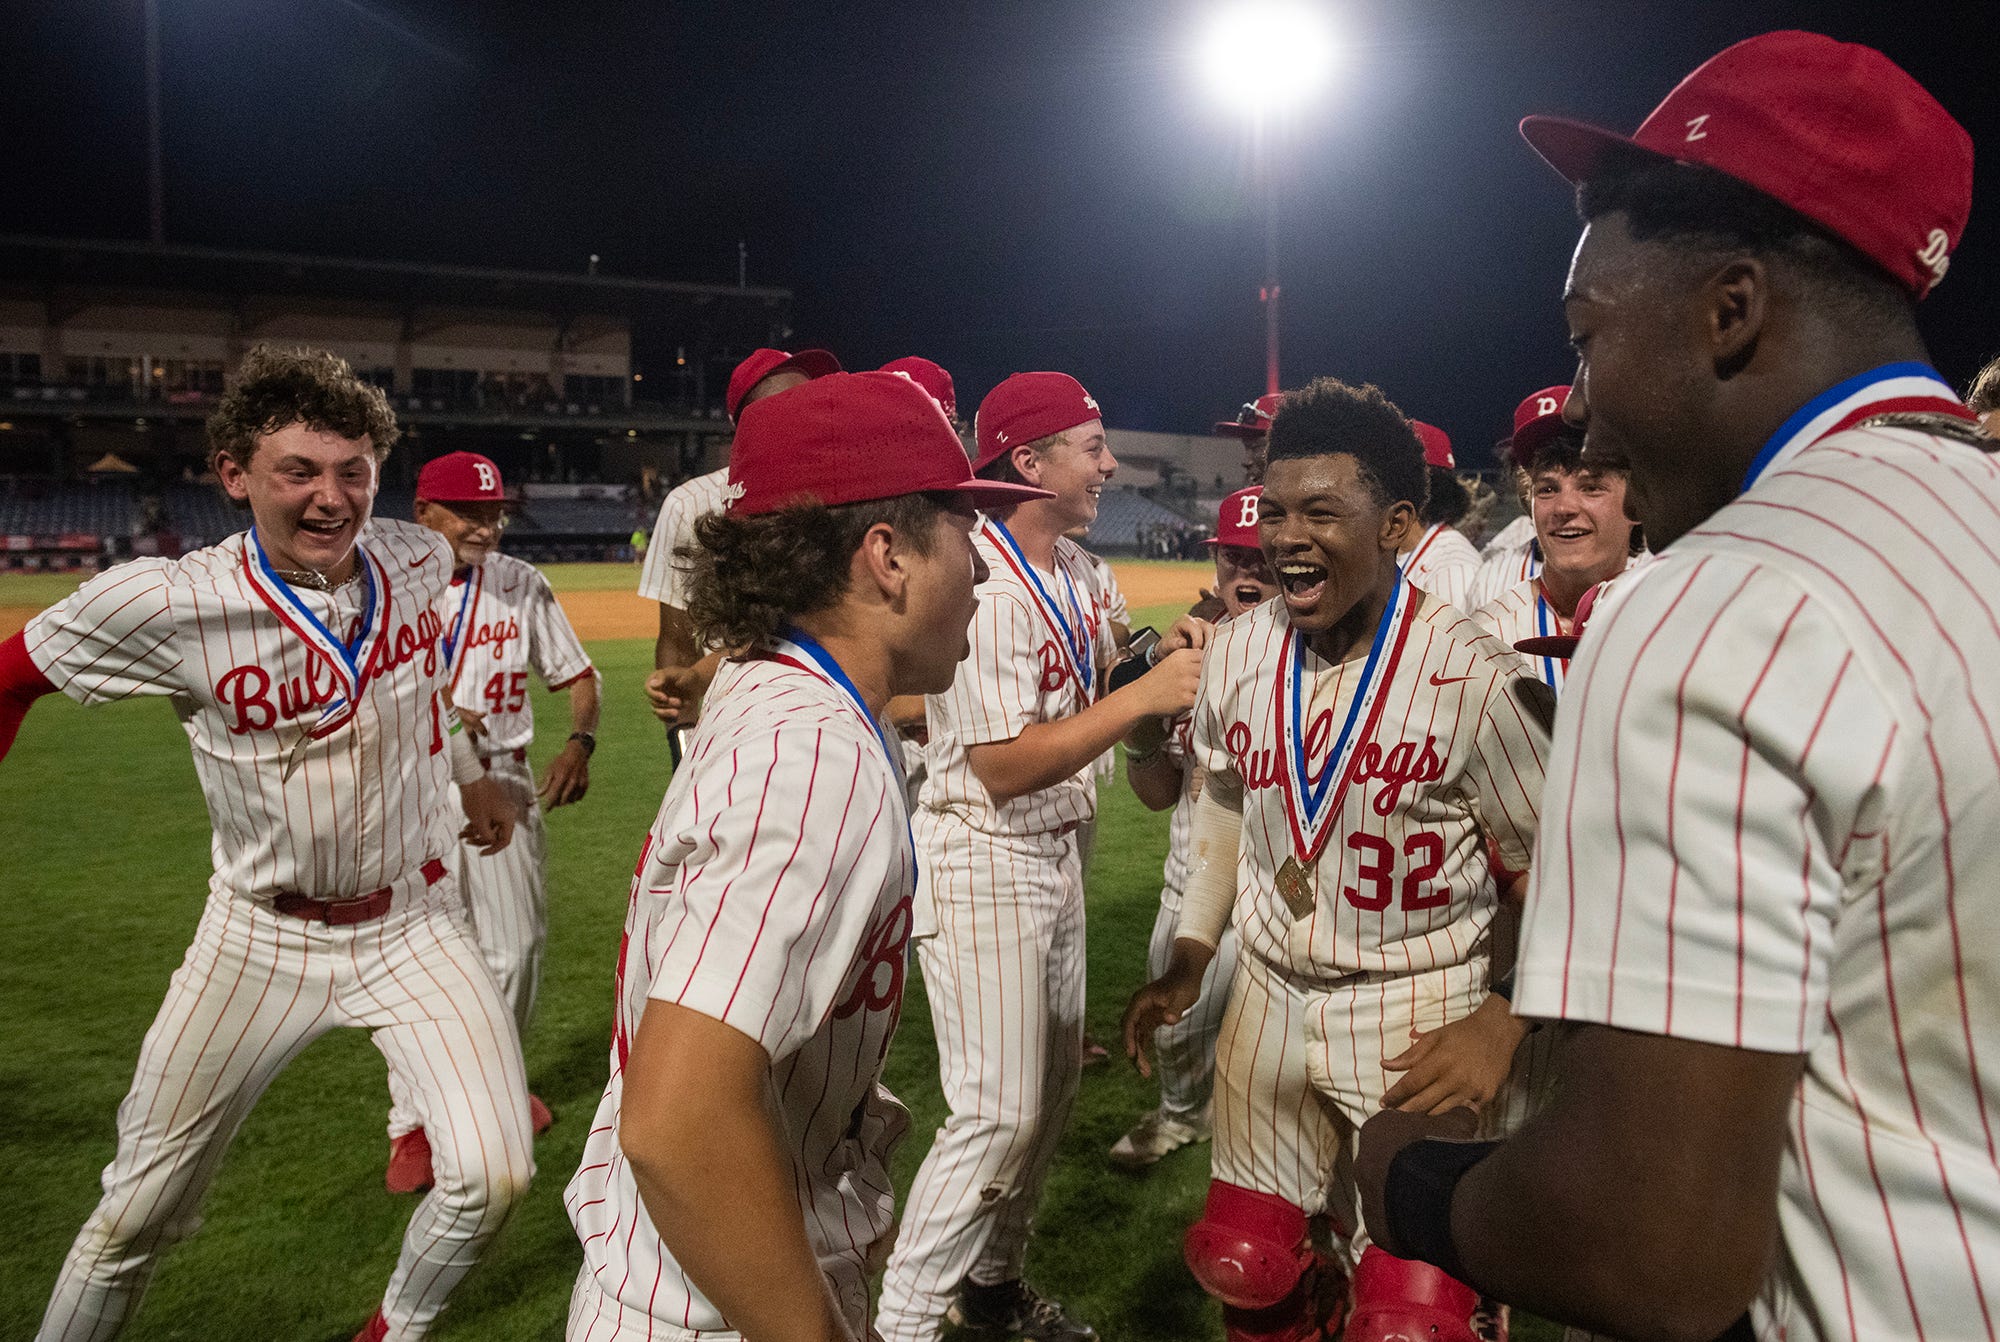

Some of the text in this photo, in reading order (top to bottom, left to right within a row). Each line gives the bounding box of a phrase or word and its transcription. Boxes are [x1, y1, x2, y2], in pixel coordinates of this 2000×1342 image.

[473, 463, 495, 491] B
[1236, 495, 1259, 528] B
[484, 672, 528, 714] 45
[1344, 831, 1450, 912] 32
